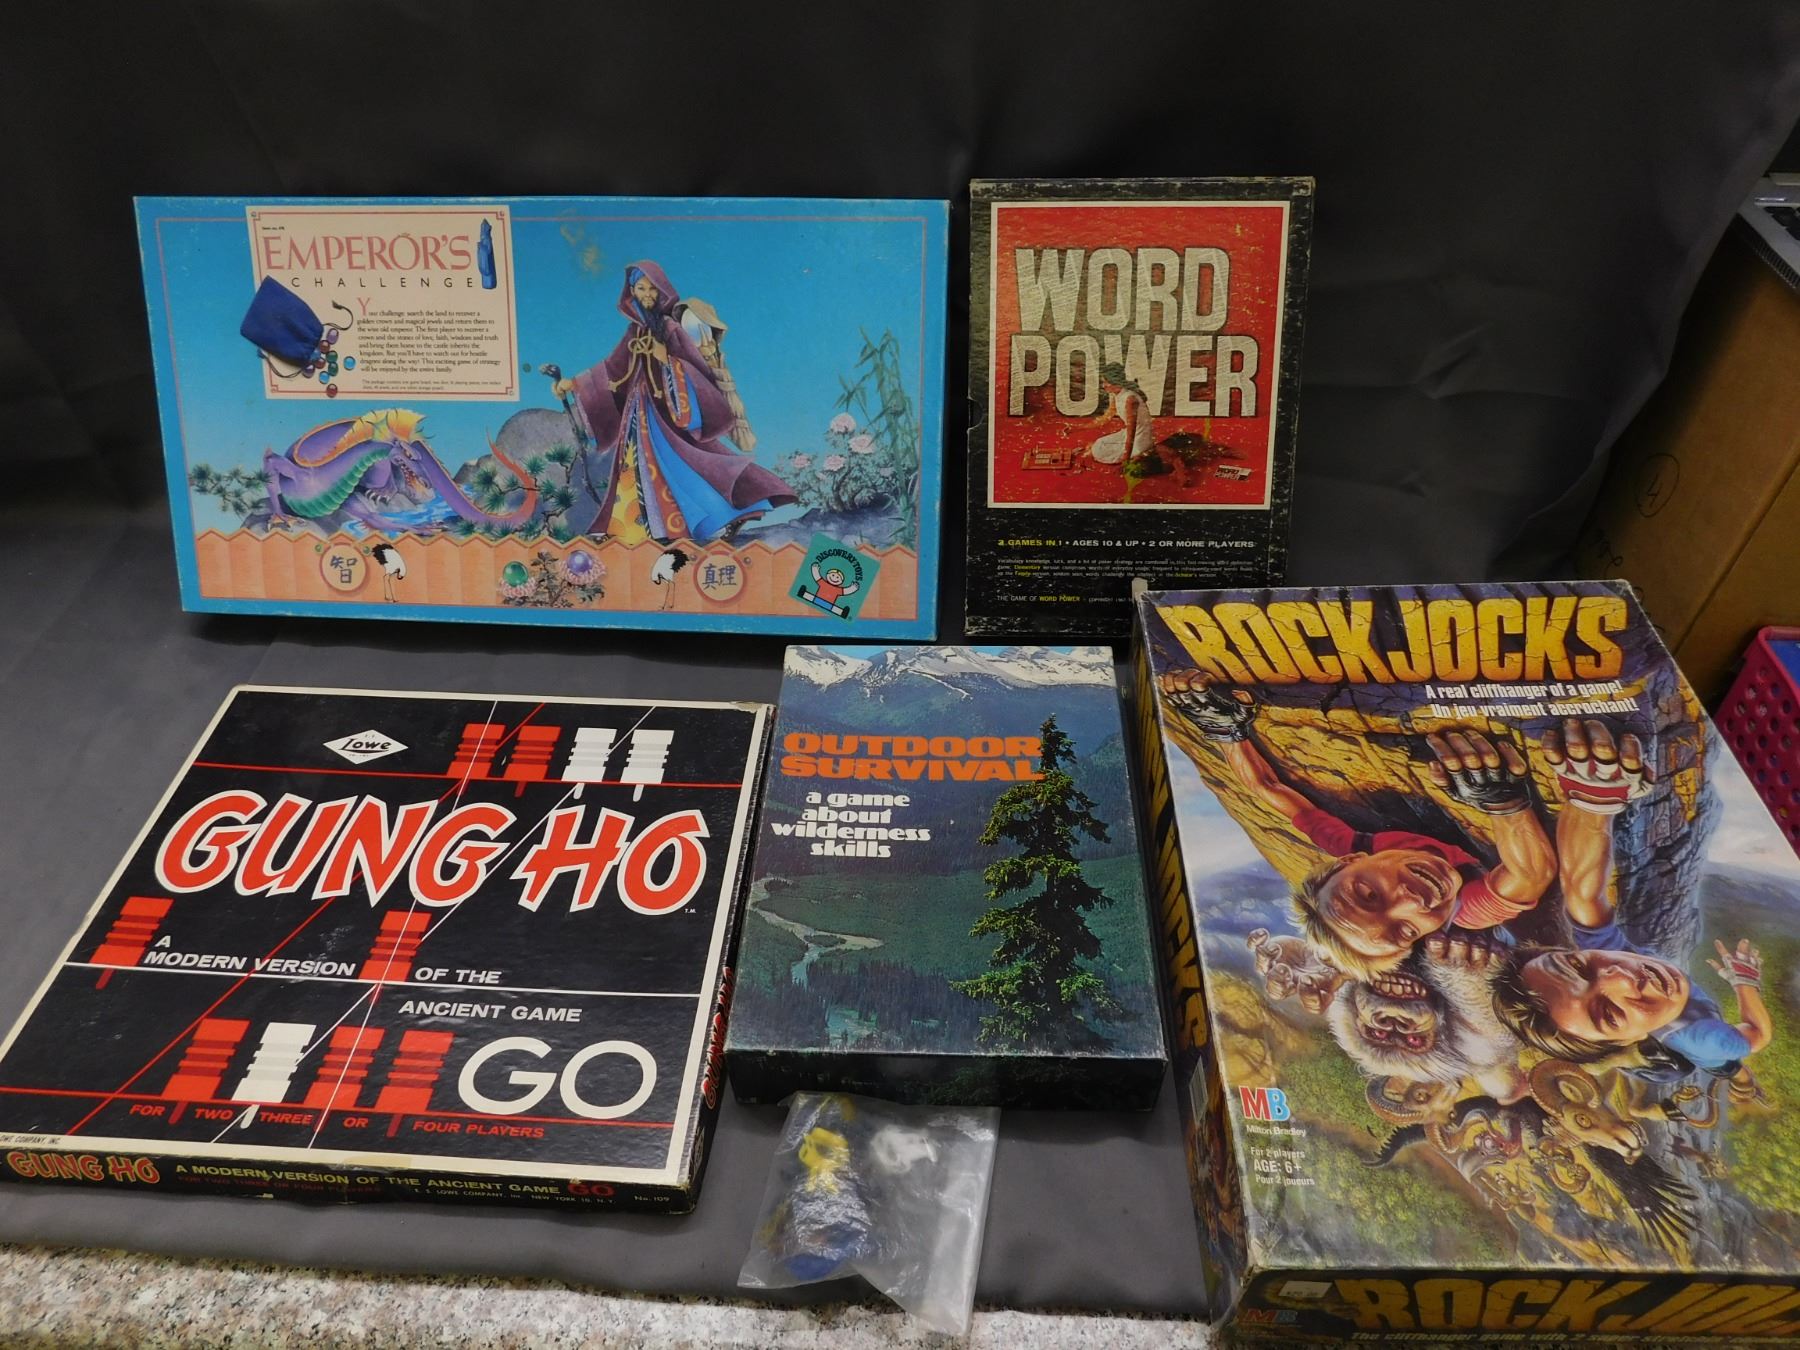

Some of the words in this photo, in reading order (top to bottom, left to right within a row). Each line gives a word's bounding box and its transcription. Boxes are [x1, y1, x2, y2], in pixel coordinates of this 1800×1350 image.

[262, 233, 472, 271] EMPEROR'S
[291, 277, 473, 288] CHALLENGE
[1015, 247, 1231, 332] WORD
[1008, 333, 1259, 417] POWER
[1208, 541, 1254, 549] PLAYERS
[330, 555, 357, 584] 智
[702, 563, 737, 591] 真理
[816, 548, 856, 564] DISCOVERY
[852, 562, 863, 581] TOYS
[1156, 600, 1398, 685] ROCK
[1388, 596, 1628, 684] JOCKS
[1426, 684, 1436, 699] A
[1439, 684, 1468, 699] real
[1470, 683, 1548, 700] cliffhanger
[1551, 682, 1567, 697] of
[1568, 684, 1578, 696] a
[1581, 680, 1625, 697] game!
[1431, 704, 1450, 718] Un
[1454, 704, 1478, 721] jeu
[1478, 702, 1547, 718] vraiment
[1549, 697, 1640, 716] accrochant!
[783, 732, 1042, 758] OUTDOOR
[781, 755, 1046, 782] SURVIVAL
[805, 791, 822, 804] a
[826, 792, 911, 808] game
[802, 806, 892, 825] about
[770, 822, 931, 842] wilderness
[154, 789, 518, 908] GUNG
[510, 806, 711, 916] HO
[810, 840, 891, 858] skills
[155, 935, 171, 948] A
[144, 951, 248, 971] MODERN
[254, 958, 357, 977] VERSION
[415, 967, 450, 982] OF
[456, 969, 503, 985] THE
[398, 1000, 507, 1020] ANCIENT
[510, 1006, 583, 1023] GAME
[457, 1035, 657, 1120] GO
[1239, 1085, 1291, 1121] MB
[129, 1104, 166, 1117] FOR
[194, 1107, 235, 1121] TWO
[259, 1111, 314, 1125] THREE
[343, 1117, 369, 1128] OR
[411, 1120, 462, 1134] FOUR
[465, 1124, 545, 1139] PLAYERS
[1246, 1124, 1272, 1136] Milton
[1273, 1126, 1306, 1138] Bradley
[1251, 1146, 1264, 1155] For
[1266, 1147, 1272, 1155] 2
[1273, 1148, 1306, 1160] players
[1253, 1159, 1282, 1173] AGE:
[7, 1151, 105, 1182] GUNG
[107, 1155, 160, 1185] HO
[176, 1164, 188, 1174] A
[192, 1165, 269, 1179] MODERN
[272, 1170, 350, 1185] VERSION
[357, 1176, 382, 1185] OF
[385, 1177, 422, 1187] THE
[427, 1179, 502, 1191] ANCIENT
[509, 1183, 561, 1194] GAME
[567, 1183, 616, 1197] GO
[1255, 1174, 1274, 1185] Pour
[1276, 1176, 1282, 1184] 2
[1283, 1177, 1316, 1187] joueurs
[1336, 1279, 1651, 1331] ROCK
